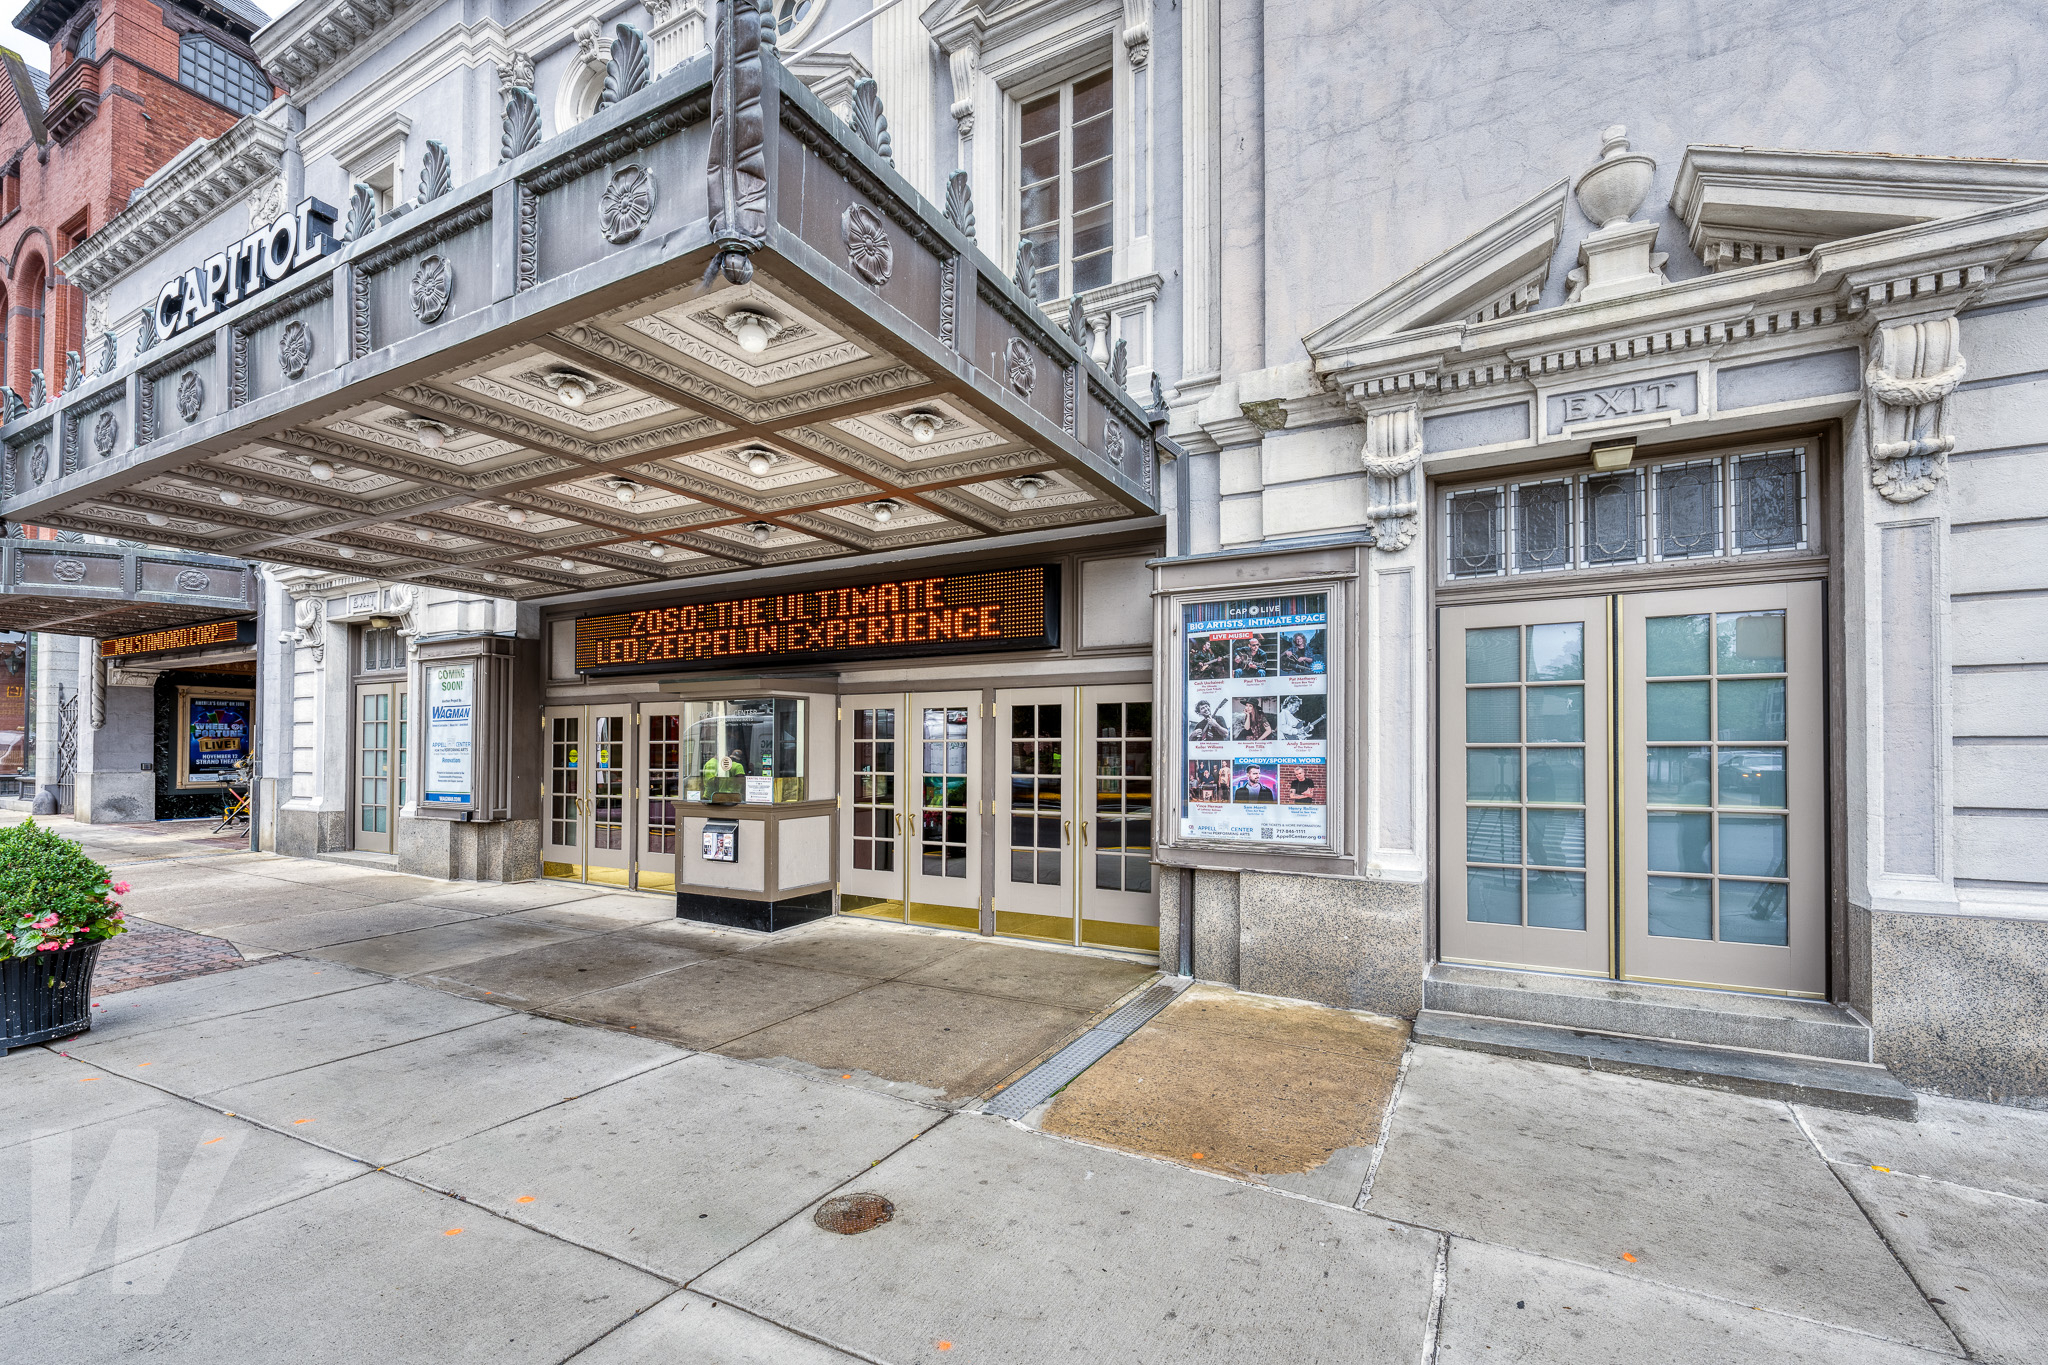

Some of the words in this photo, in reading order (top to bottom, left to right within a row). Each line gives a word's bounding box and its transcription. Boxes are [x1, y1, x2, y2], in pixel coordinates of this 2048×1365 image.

[154, 196, 328, 340] CAPITOL
[1563, 381, 1677, 422] EXIT
[353, 594, 376, 609] EXIT
[631, 605, 704, 636] ZOSO:
[714, 598, 766, 627] THE
[777, 578, 944, 621] ULTIMATE
[1229, 608, 1248, 616] CAP
[1260, 605, 1281, 613] LIVE
[1189, 623, 1205, 631] BIG
[1206, 620, 1246, 629] ARTISTS,
[1249, 616, 1292, 626] INTIMATE
[1295, 613, 1326, 623] SPACE
[117, 637, 133, 655] NEW
[134, 628, 187, 653] STANDARD
[189, 624, 219, 645] CORP
[597, 639, 638, 664] LED
[647, 625, 778, 660] ZEPPELIN
[787, 606, 1001, 650] EXPERIENCE
[438, 669, 465, 680] COMING
[441, 681, 463, 691] SOON!
[432, 706, 471, 719] WAGMAN
[733, 708, 758, 716] CENTER
[195, 729, 244, 738] FORTUNE
[205, 740, 236, 750] LIVE!
